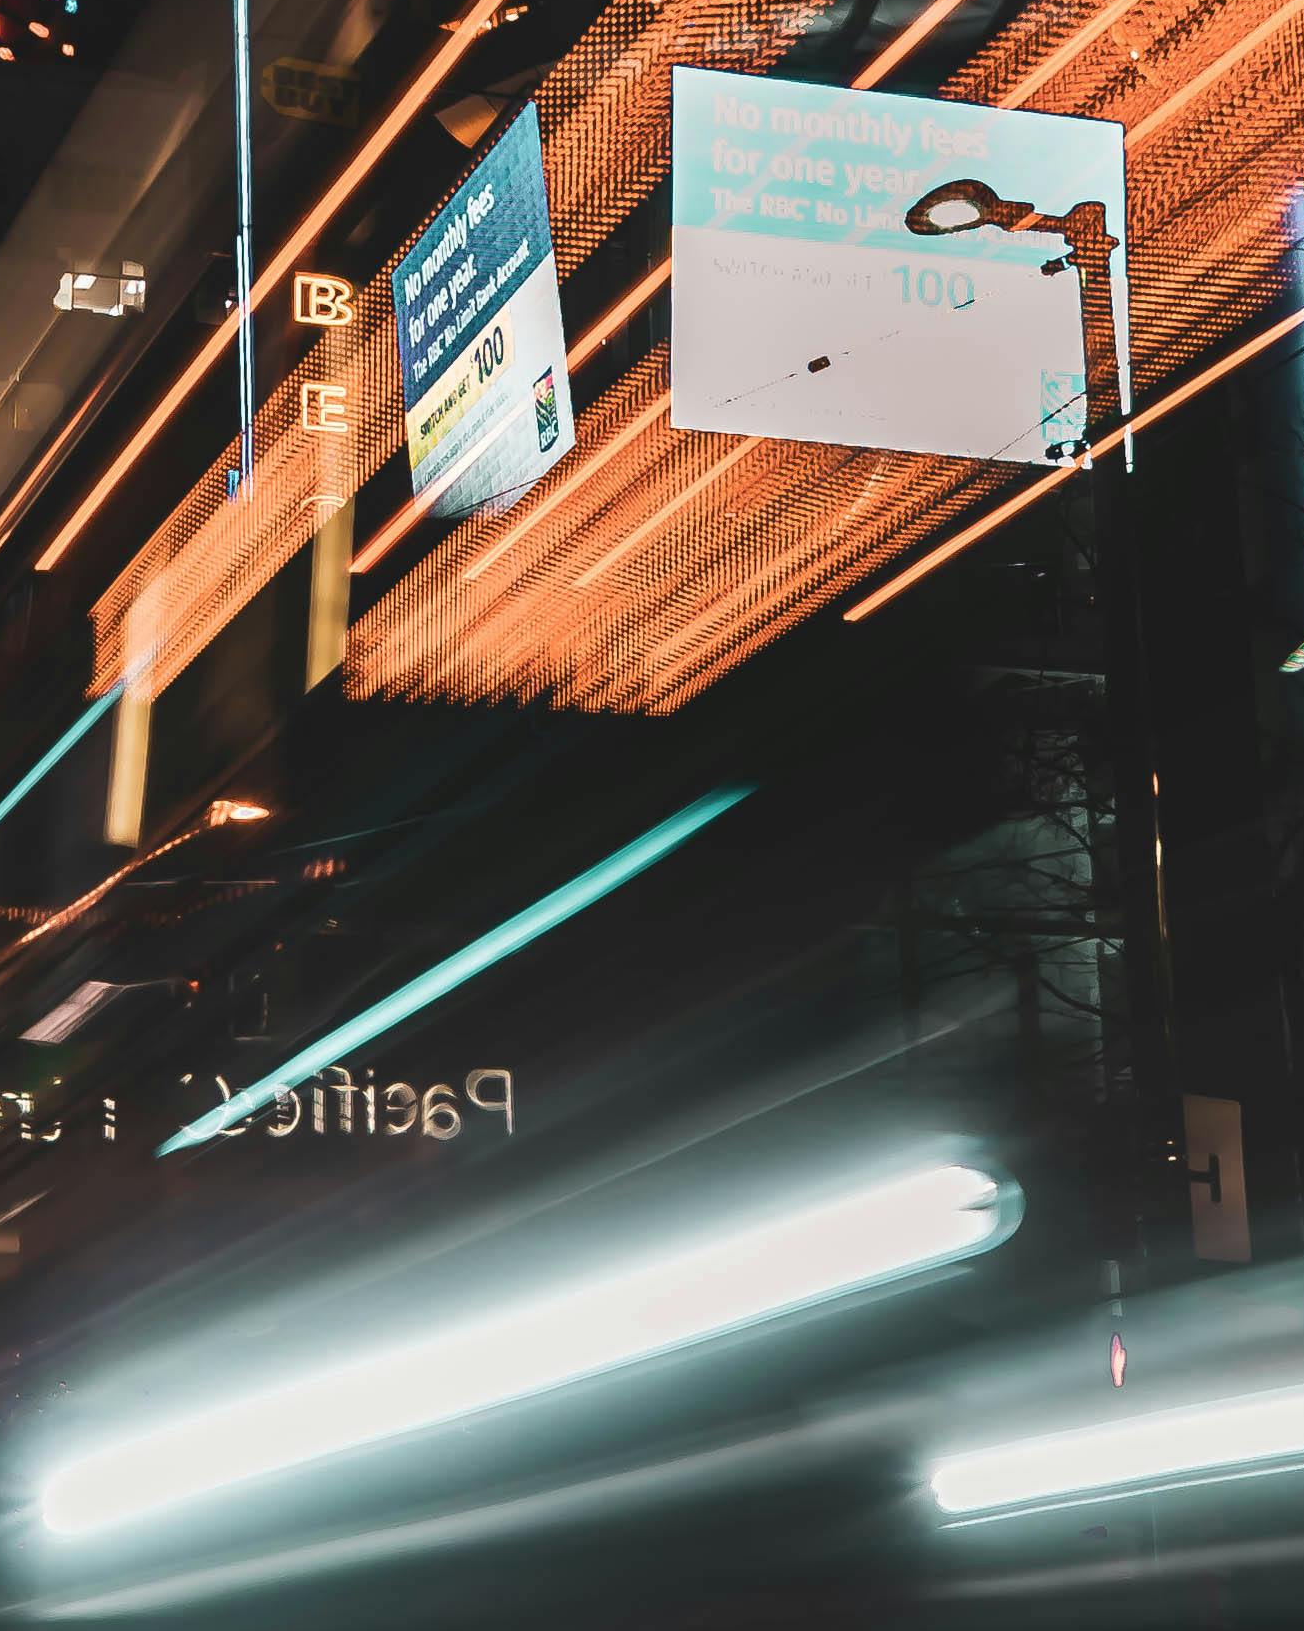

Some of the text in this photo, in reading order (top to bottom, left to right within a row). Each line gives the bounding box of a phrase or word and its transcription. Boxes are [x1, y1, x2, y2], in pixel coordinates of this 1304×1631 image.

[713, 94, 989, 159] No monthly fees
[712, 138, 766, 175] for
[771, 152, 835, 185] one
[404, 183, 494, 306] No monthly fees
[409, 310, 427, 348] for
[427, 291, 448, 327] one
[414, 355, 427, 383] The
[540, 421, 559, 447] RBC
